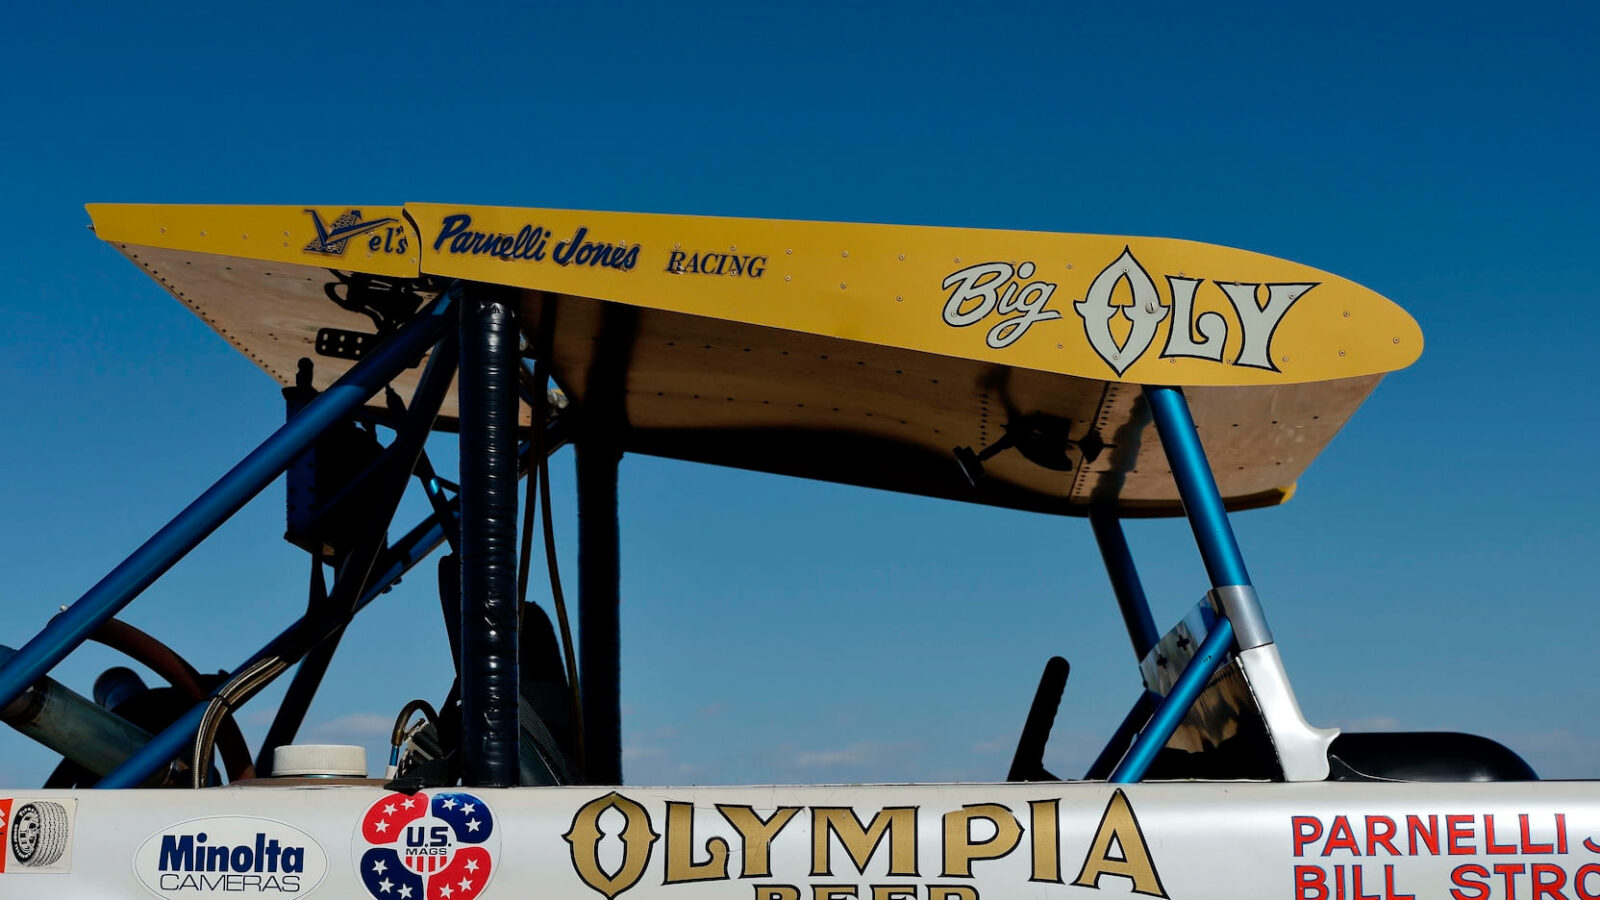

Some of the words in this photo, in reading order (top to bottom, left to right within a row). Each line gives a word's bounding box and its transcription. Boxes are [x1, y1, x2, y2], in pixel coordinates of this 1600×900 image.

[433, 214, 551, 262] Parnelli
[552, 226, 641, 271] Jones
[666, 250, 767, 279] RACING
[942, 261, 1063, 349] Big
[1073, 244, 1322, 378] OLY
[158, 833, 305, 874] Minolta
[405, 847, 447, 856] MAGS
[406, 826, 452, 848] U.S.
[561, 788, 1171, 900] OLYMPIA
[1291, 813, 1568, 857] PARNELLI
[159, 874, 301, 893] CAMERAS
[1294, 864, 1416, 900] BILL
